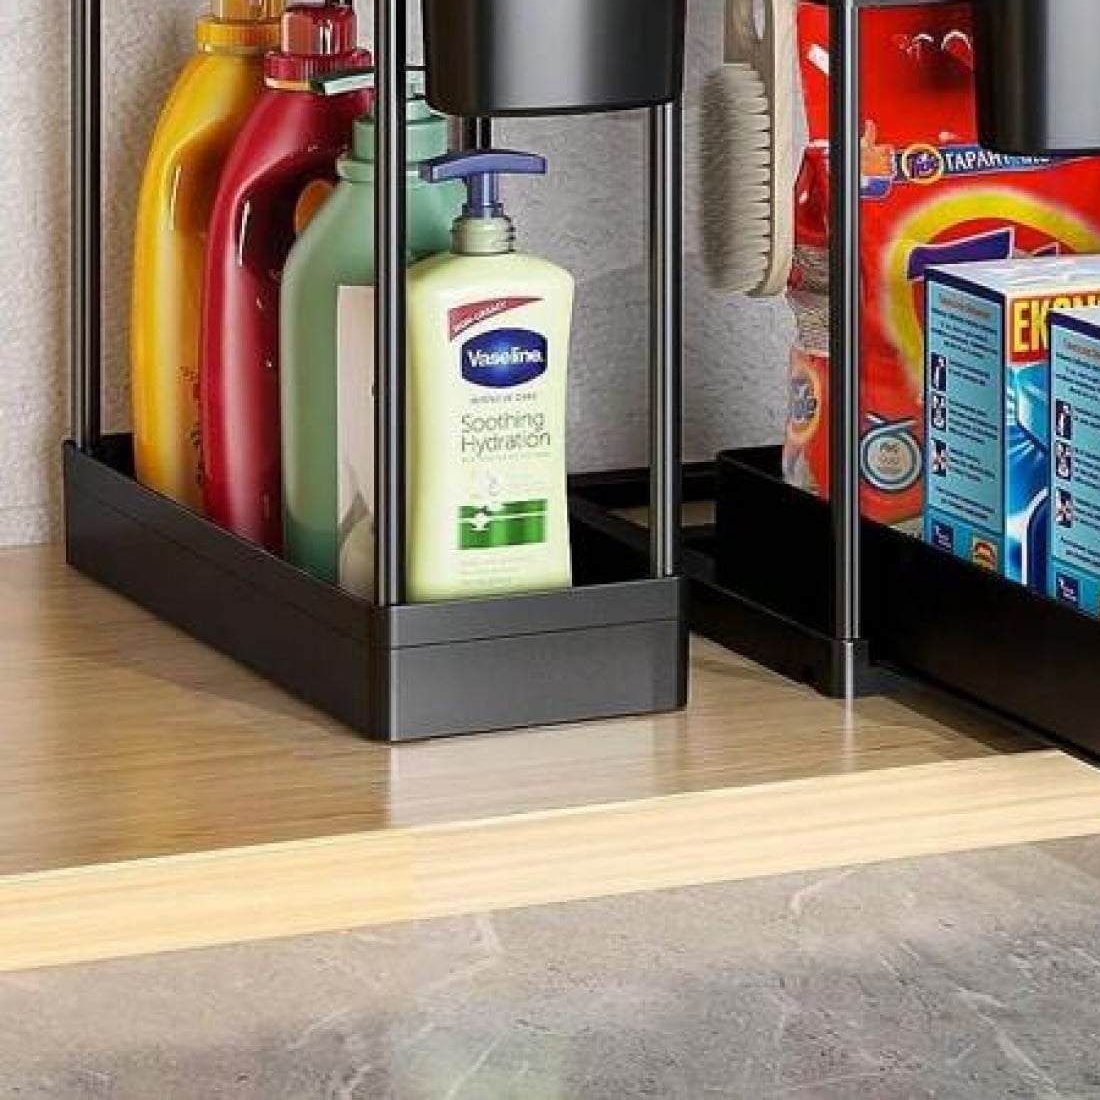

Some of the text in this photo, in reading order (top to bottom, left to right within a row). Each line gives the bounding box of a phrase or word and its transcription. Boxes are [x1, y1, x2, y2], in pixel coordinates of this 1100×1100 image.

[466, 346, 545, 368] Vaseline
[460, 411, 546, 435] Soothing
[461, 430, 551, 457] Hydration
